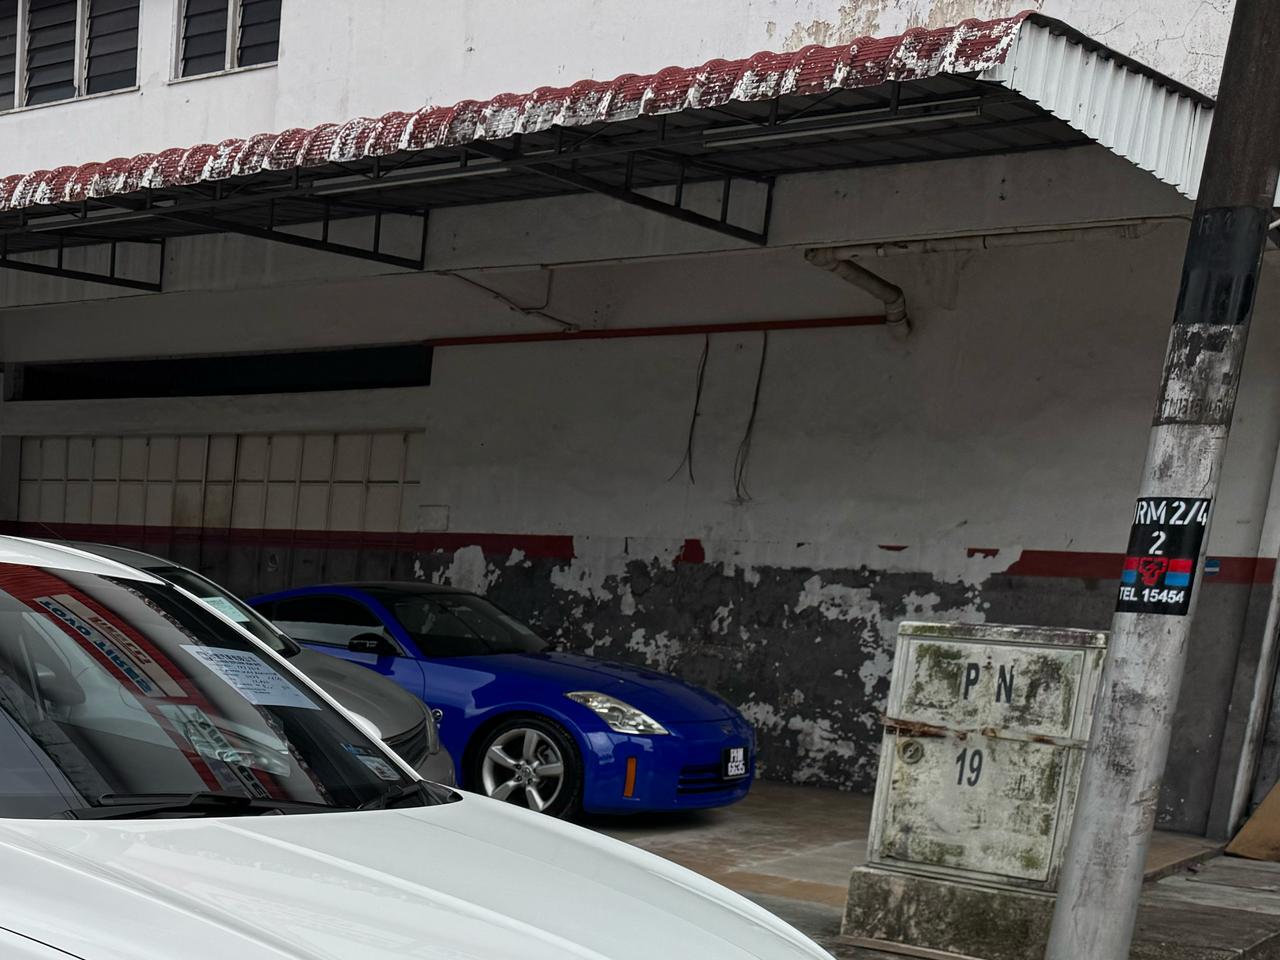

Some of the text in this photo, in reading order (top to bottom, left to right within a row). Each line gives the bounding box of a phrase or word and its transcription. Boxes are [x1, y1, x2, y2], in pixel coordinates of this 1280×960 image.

[1133, 500, 1208, 526] RM 2/4
[1148, 531, 1166, 554] 2
[1120, 587, 1185, 603] TEL 15454
[955, 747, 983, 787] 19
